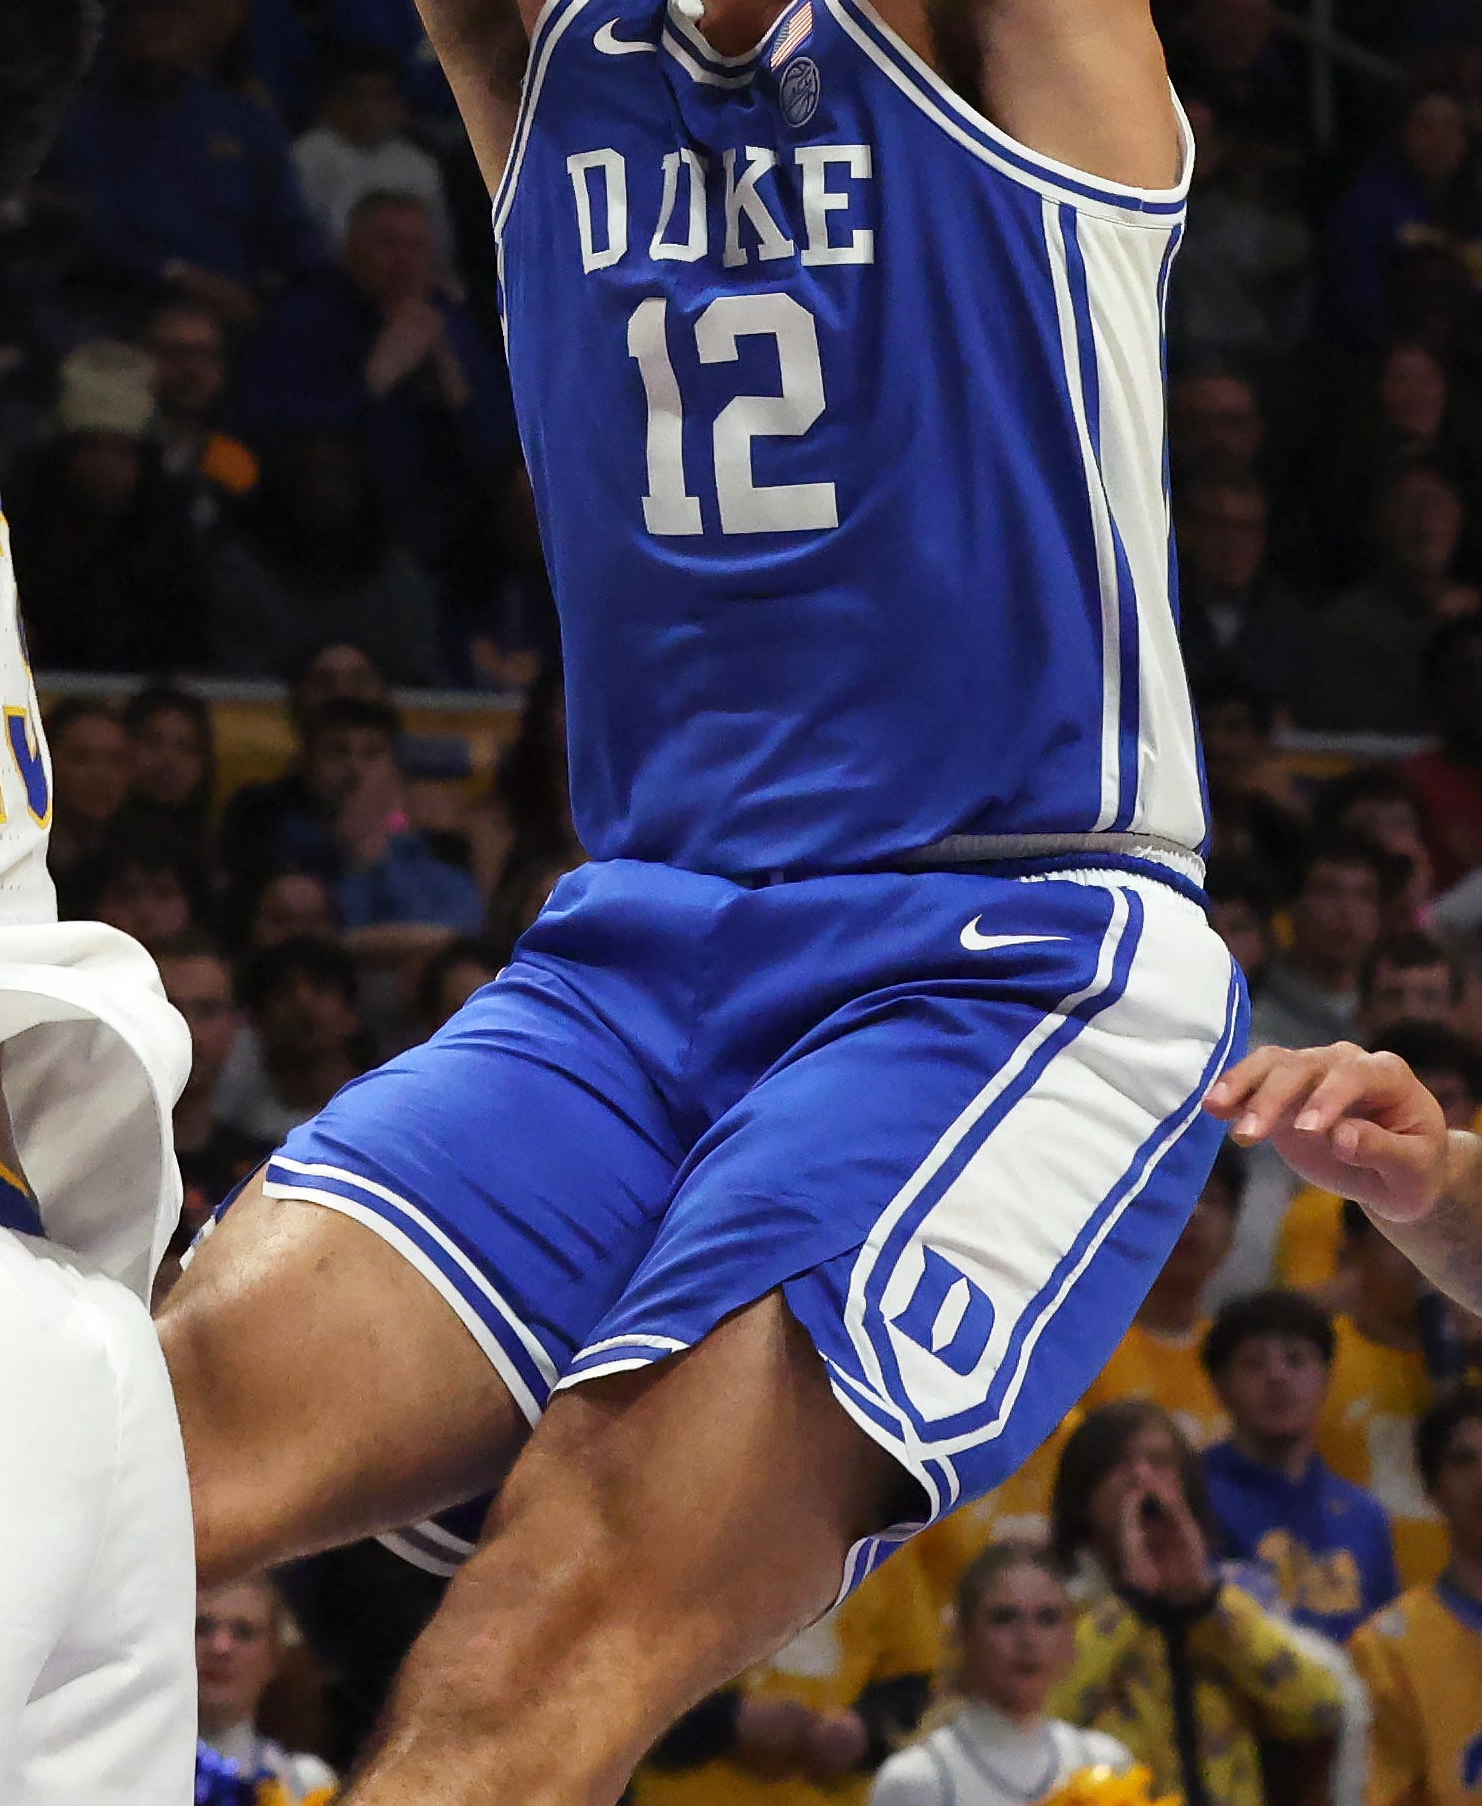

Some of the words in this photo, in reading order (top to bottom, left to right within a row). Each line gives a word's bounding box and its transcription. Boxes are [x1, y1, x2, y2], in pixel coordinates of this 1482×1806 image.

[567, 145, 875, 275] DUKE
[627, 292, 839, 535] 12
[889, 1244, 995, 1376] D
